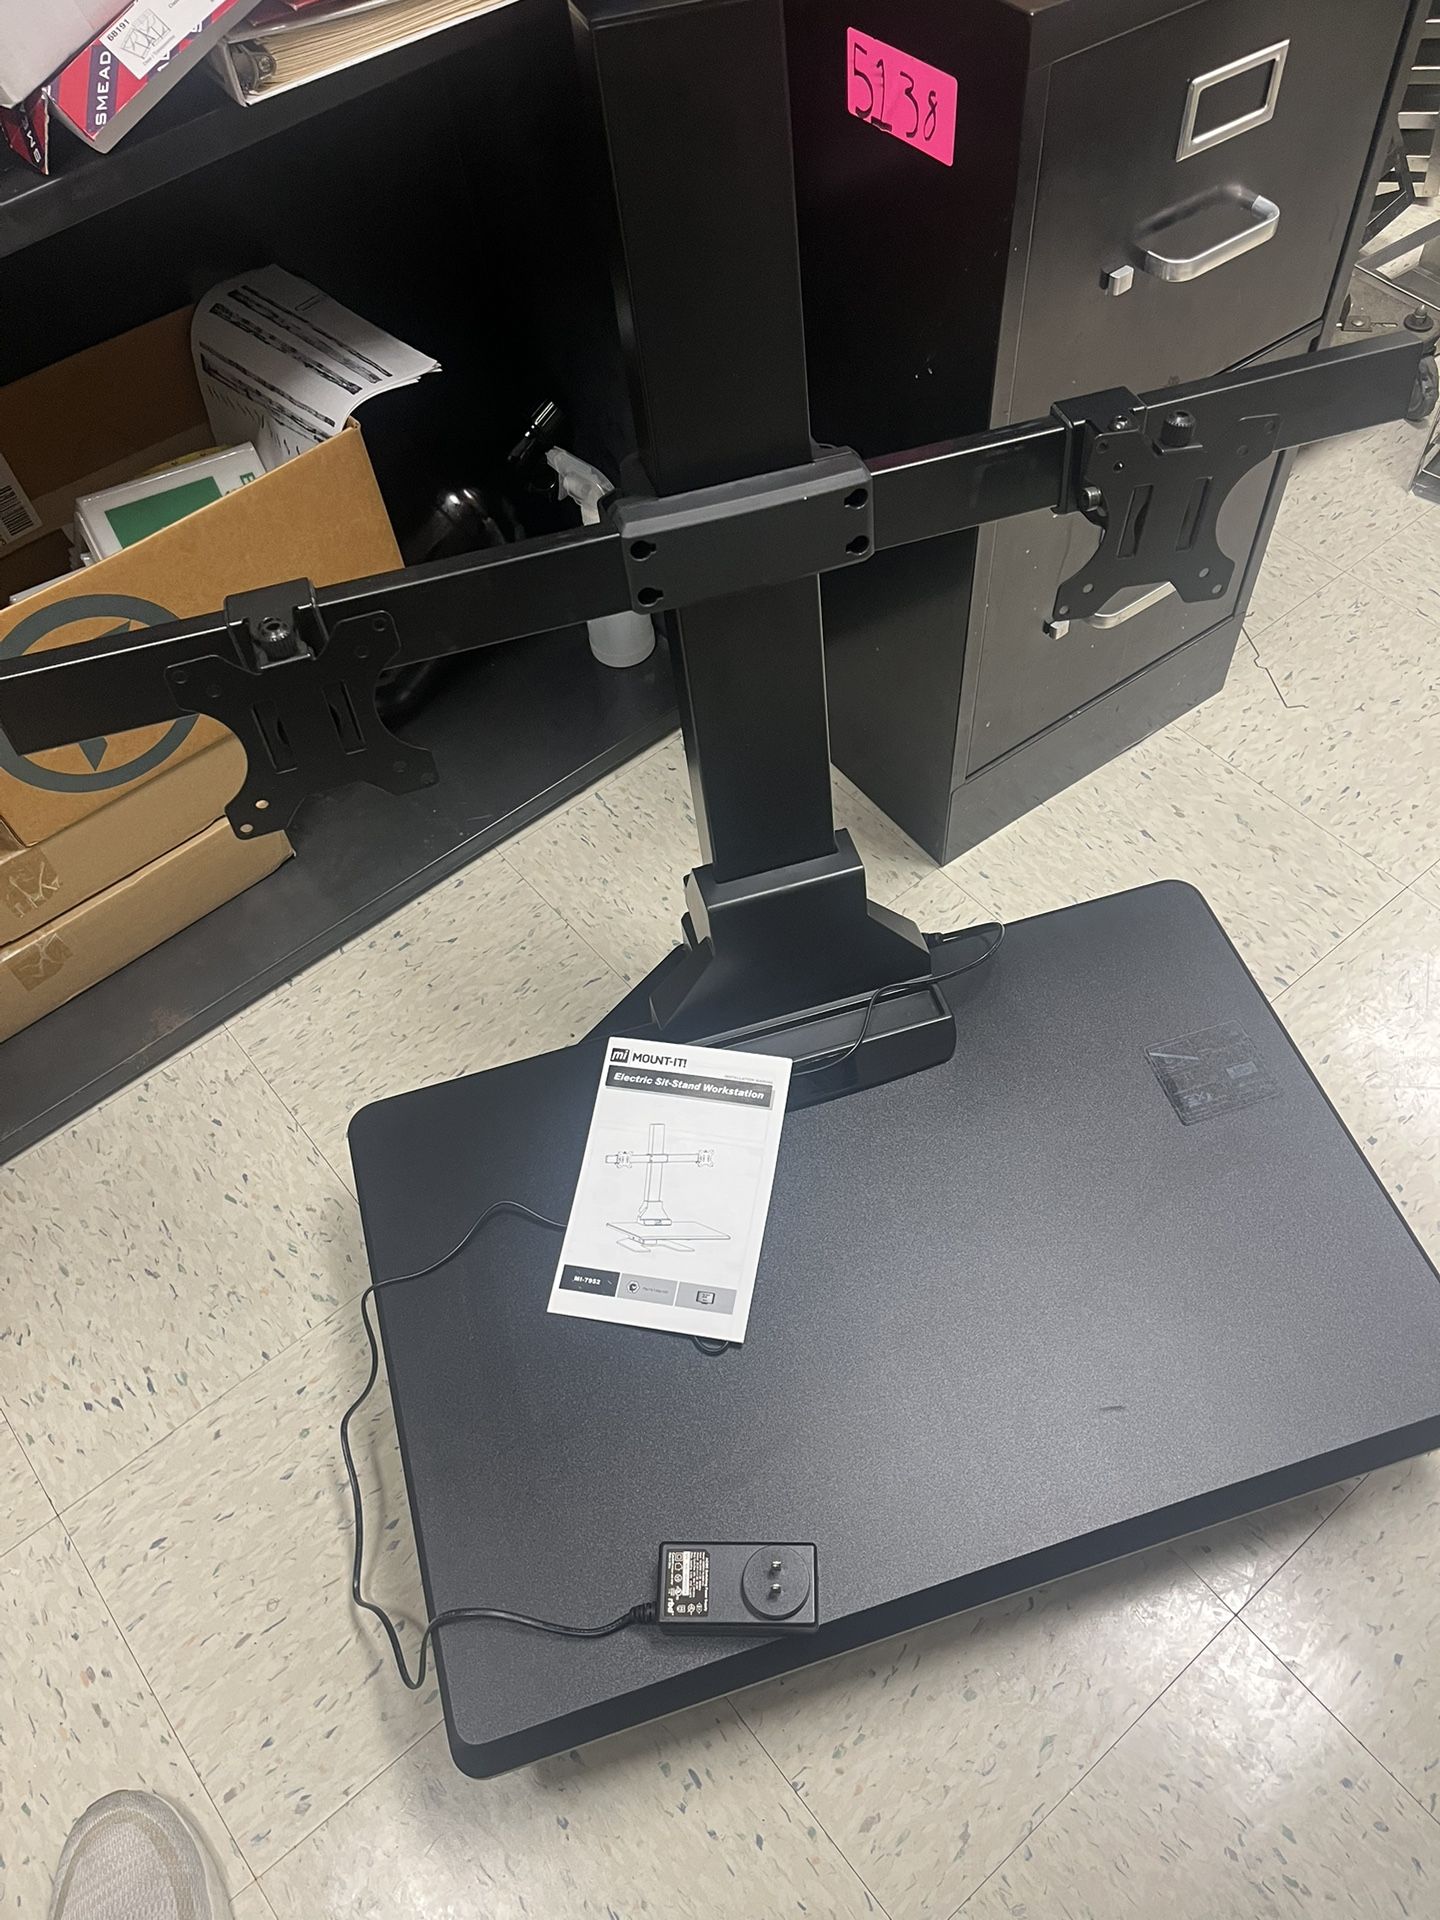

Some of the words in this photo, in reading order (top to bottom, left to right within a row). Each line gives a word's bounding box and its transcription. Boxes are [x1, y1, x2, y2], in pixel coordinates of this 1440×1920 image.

[107, 18, 131, 42] 68191
[95, 51, 112, 126] SMEAD
[853, 42, 938, 142] 5138
[632, 1052, 688, 1068] MOUNT-IT!
[613, 1072, 653, 1085] Electric
[654, 1077, 702, 1091] Sit-Stand
[702, 1083, 765, 1100] Workstation
